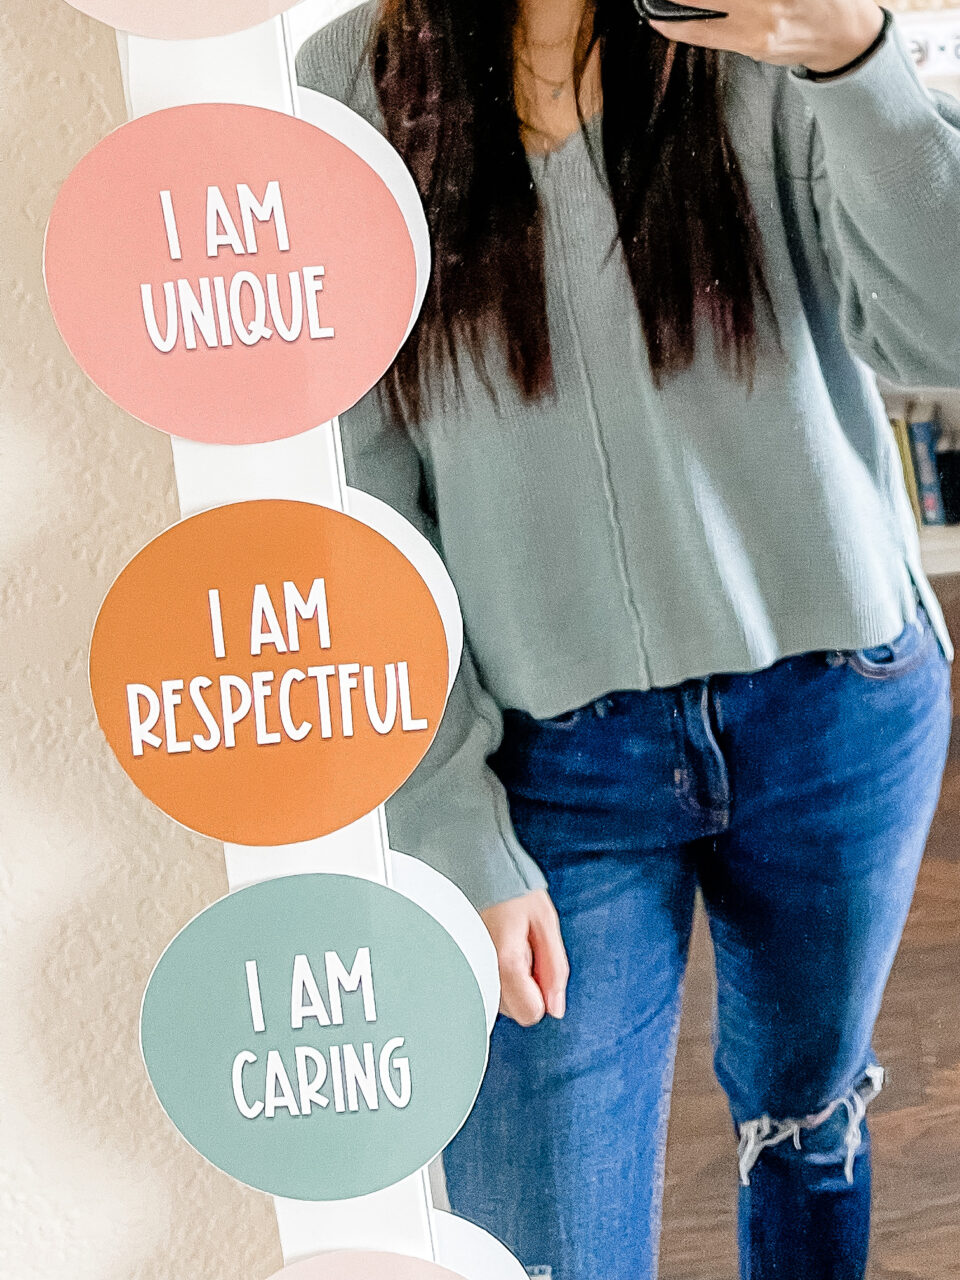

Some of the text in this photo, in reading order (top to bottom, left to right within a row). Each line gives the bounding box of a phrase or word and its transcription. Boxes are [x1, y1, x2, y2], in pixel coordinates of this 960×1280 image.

[159, 180, 290, 260] I AM
[140, 265, 335, 352] UNIQUE
[208, 577, 331, 658] I AM
[126, 661, 428, 756] RESPECTFUL
[245, 946, 377, 1032] I AM
[232, 1036, 411, 1119] CARING
